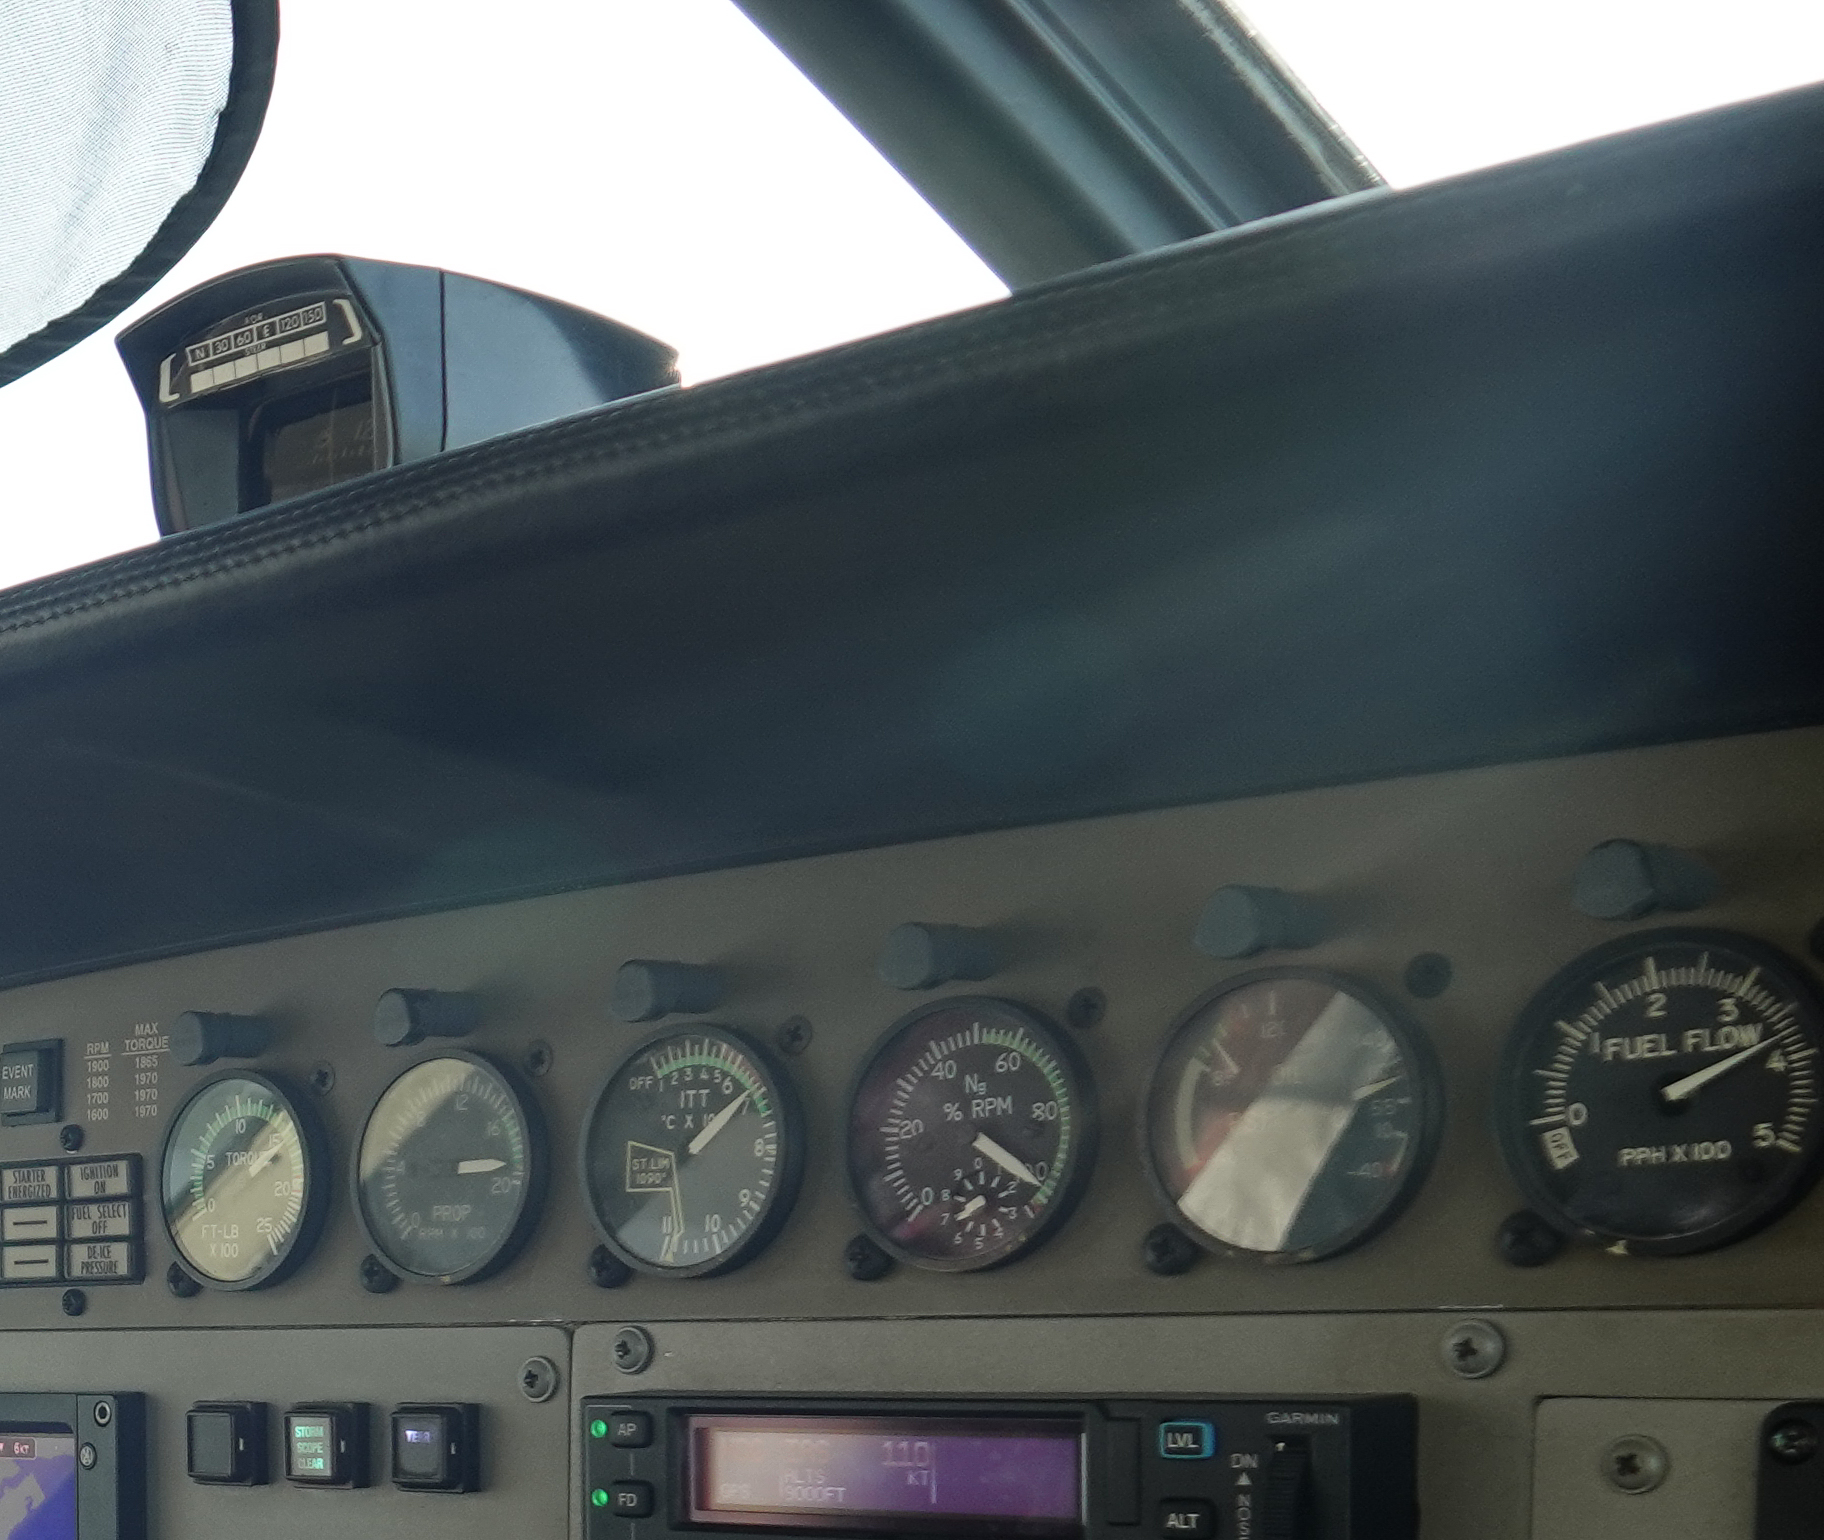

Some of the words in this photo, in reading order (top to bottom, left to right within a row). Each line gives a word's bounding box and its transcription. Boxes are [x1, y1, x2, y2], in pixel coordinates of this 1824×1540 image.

[214, 339, 229, 353] 30
[236, 331, 251, 346] 60
[279, 314, 300, 330] 120
[302, 308, 322, 323] 150
[1645, 992, 1668, 1018] 2
[1717, 997, 1739, 1022] 3
[134, 1022, 159, 1036] MAX
[86, 1041, 110, 1055] RPM
[124, 1035, 170, 1051] TORQUE
[1603, 1033, 1678, 1061] FUEL
[1683, 1022, 1764, 1052] FLOW
[931, 1060, 957, 1080] 40
[995, 1051, 1021, 1073] 60
[2, 1063, 34, 1080] EVENT
[629, 1076, 653, 1090] OFF
[3, 1085, 32, 1100] MARK
[134, 1088, 159, 1102] 1970
[680, 1088, 711, 1109] ITT
[134, 1104, 158, 1118] 1970
[972, 1096, 1014, 1118] RPM
[1032, 1101, 1058, 1121] 80
[235, 1118, 246, 1133] 10
[900, 1119, 925, 1139] 20
[13, 1169, 46, 1184] STARTER
[80, 1163, 119, 1180] IGNITION
[8, 1184, 52, 1199] ENERGIZED
[94, 1180, 107, 1195] ON
[274, 1181, 290, 1197] 20
[490, 1177, 510, 1194] 20
[98, 1203, 127, 1218] SELECT
[91, 1220, 108, 1235] OFF
[256, 1217, 272, 1233] 25
[705, 1213, 721, 1232] 10
[202, 1224, 239, 1240] FT-LB
[80, 1260, 119, 1275] PRESSURE
[294, 1426, 324, 1438] STORM
[617, 1423, 637, 1437] AP
[1166, 1432, 1200, 1449] LVL
[298, 1457, 324, 1470] CLEAR
[617, 1492, 638, 1507] FD
[1166, 1512, 1200, 1529] ALT
